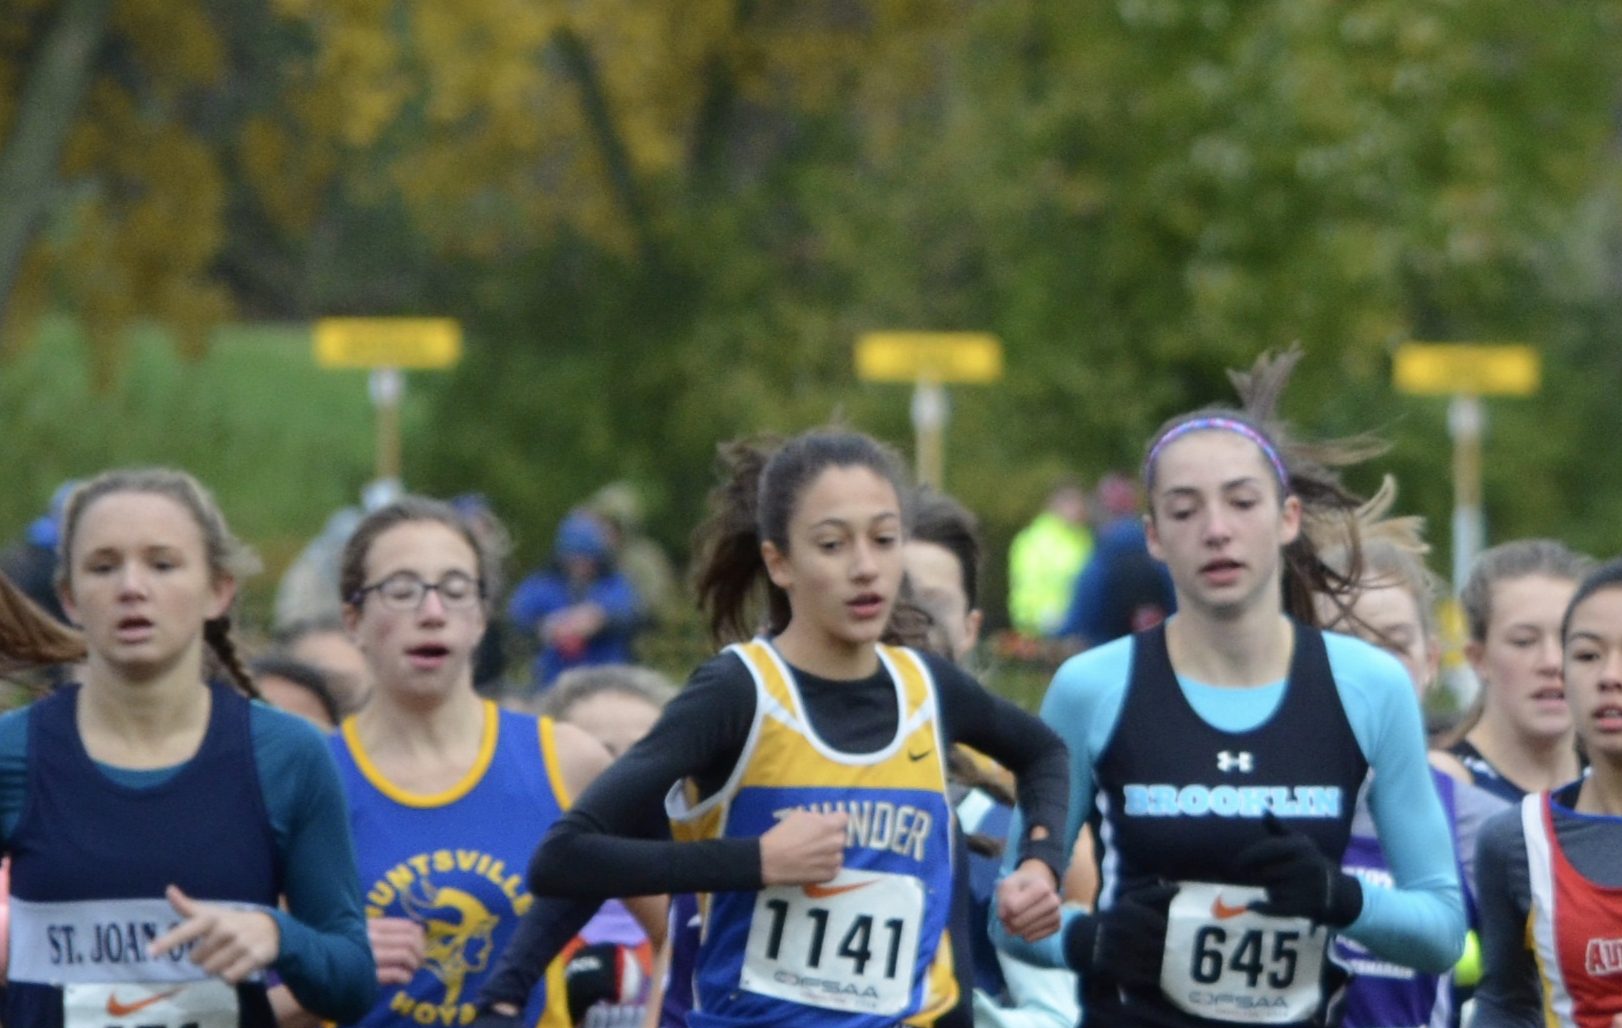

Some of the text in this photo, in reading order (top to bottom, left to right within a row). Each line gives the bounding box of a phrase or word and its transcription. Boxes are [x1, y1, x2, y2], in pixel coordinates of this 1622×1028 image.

[1123, 784, 1341, 817] BROOKLIN
[47, 922, 83, 965] ST.
[766, 899, 904, 979] 1141
[1190, 924, 1299, 989] 645
